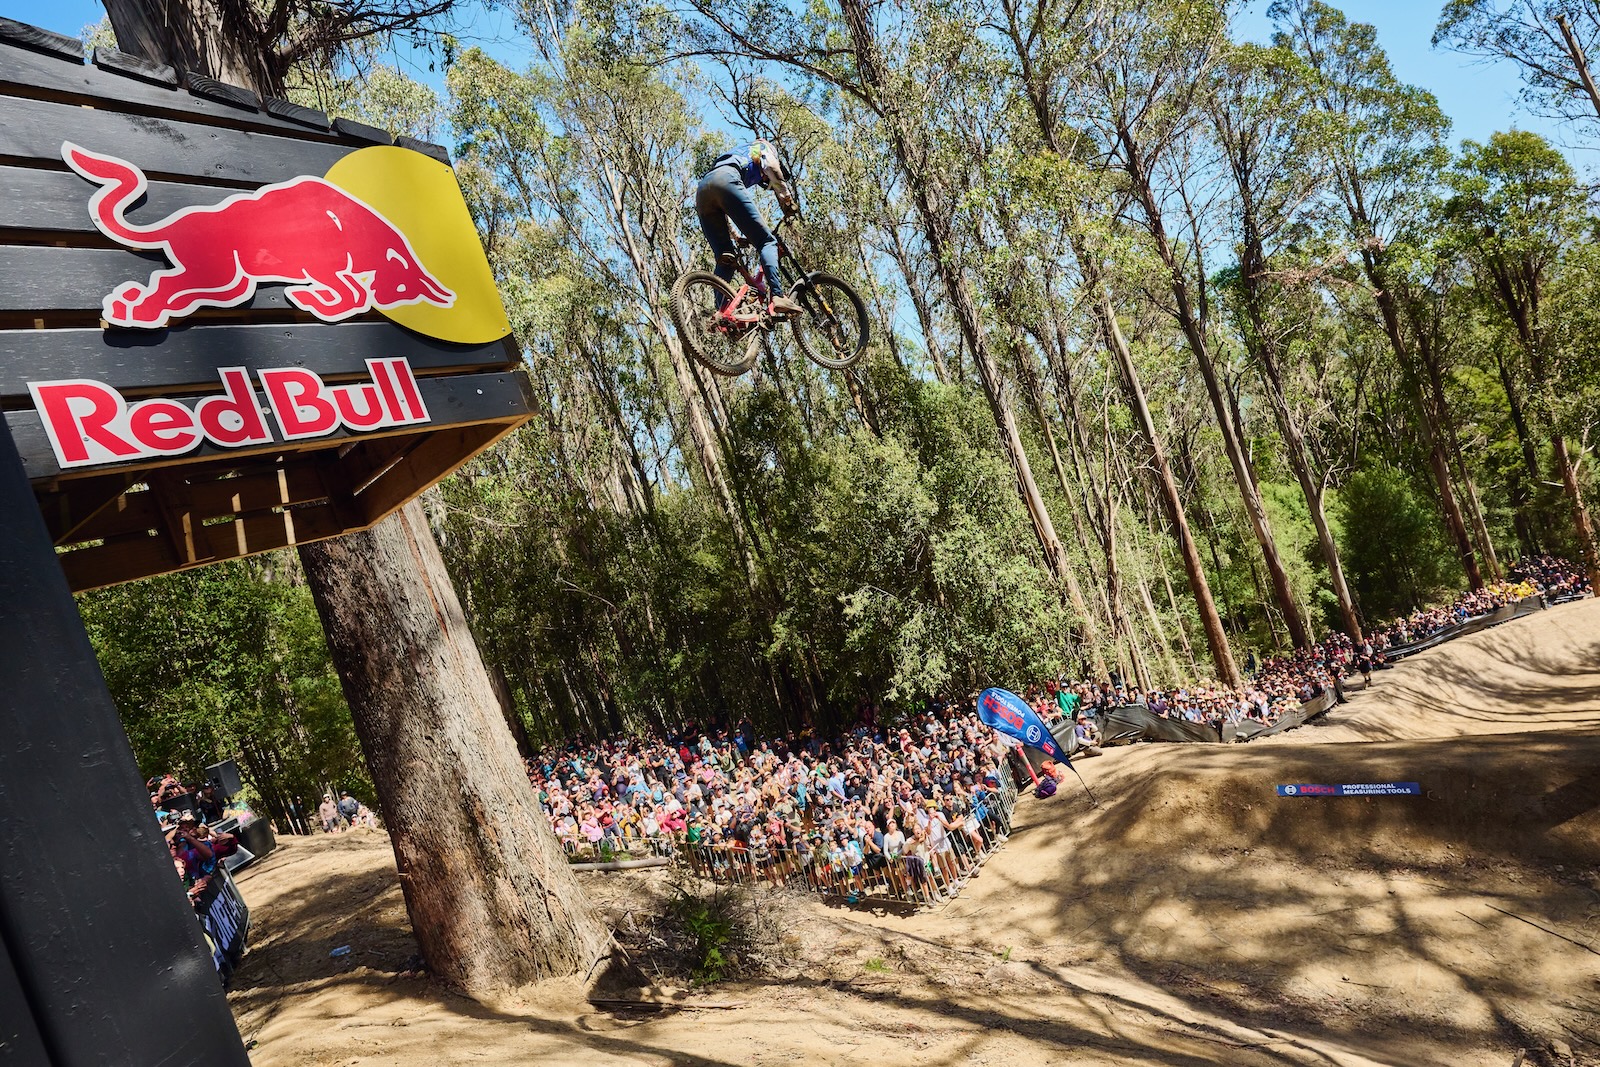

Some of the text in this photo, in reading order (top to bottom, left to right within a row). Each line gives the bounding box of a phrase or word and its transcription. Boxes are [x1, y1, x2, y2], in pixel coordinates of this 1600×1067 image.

[33, 358, 427, 465] Red Bull
[983, 695, 1025, 730] BOSCH
[991, 691, 1025, 718] POWER TOOLS
[1300, 785, 1335, 794] BOSCH
